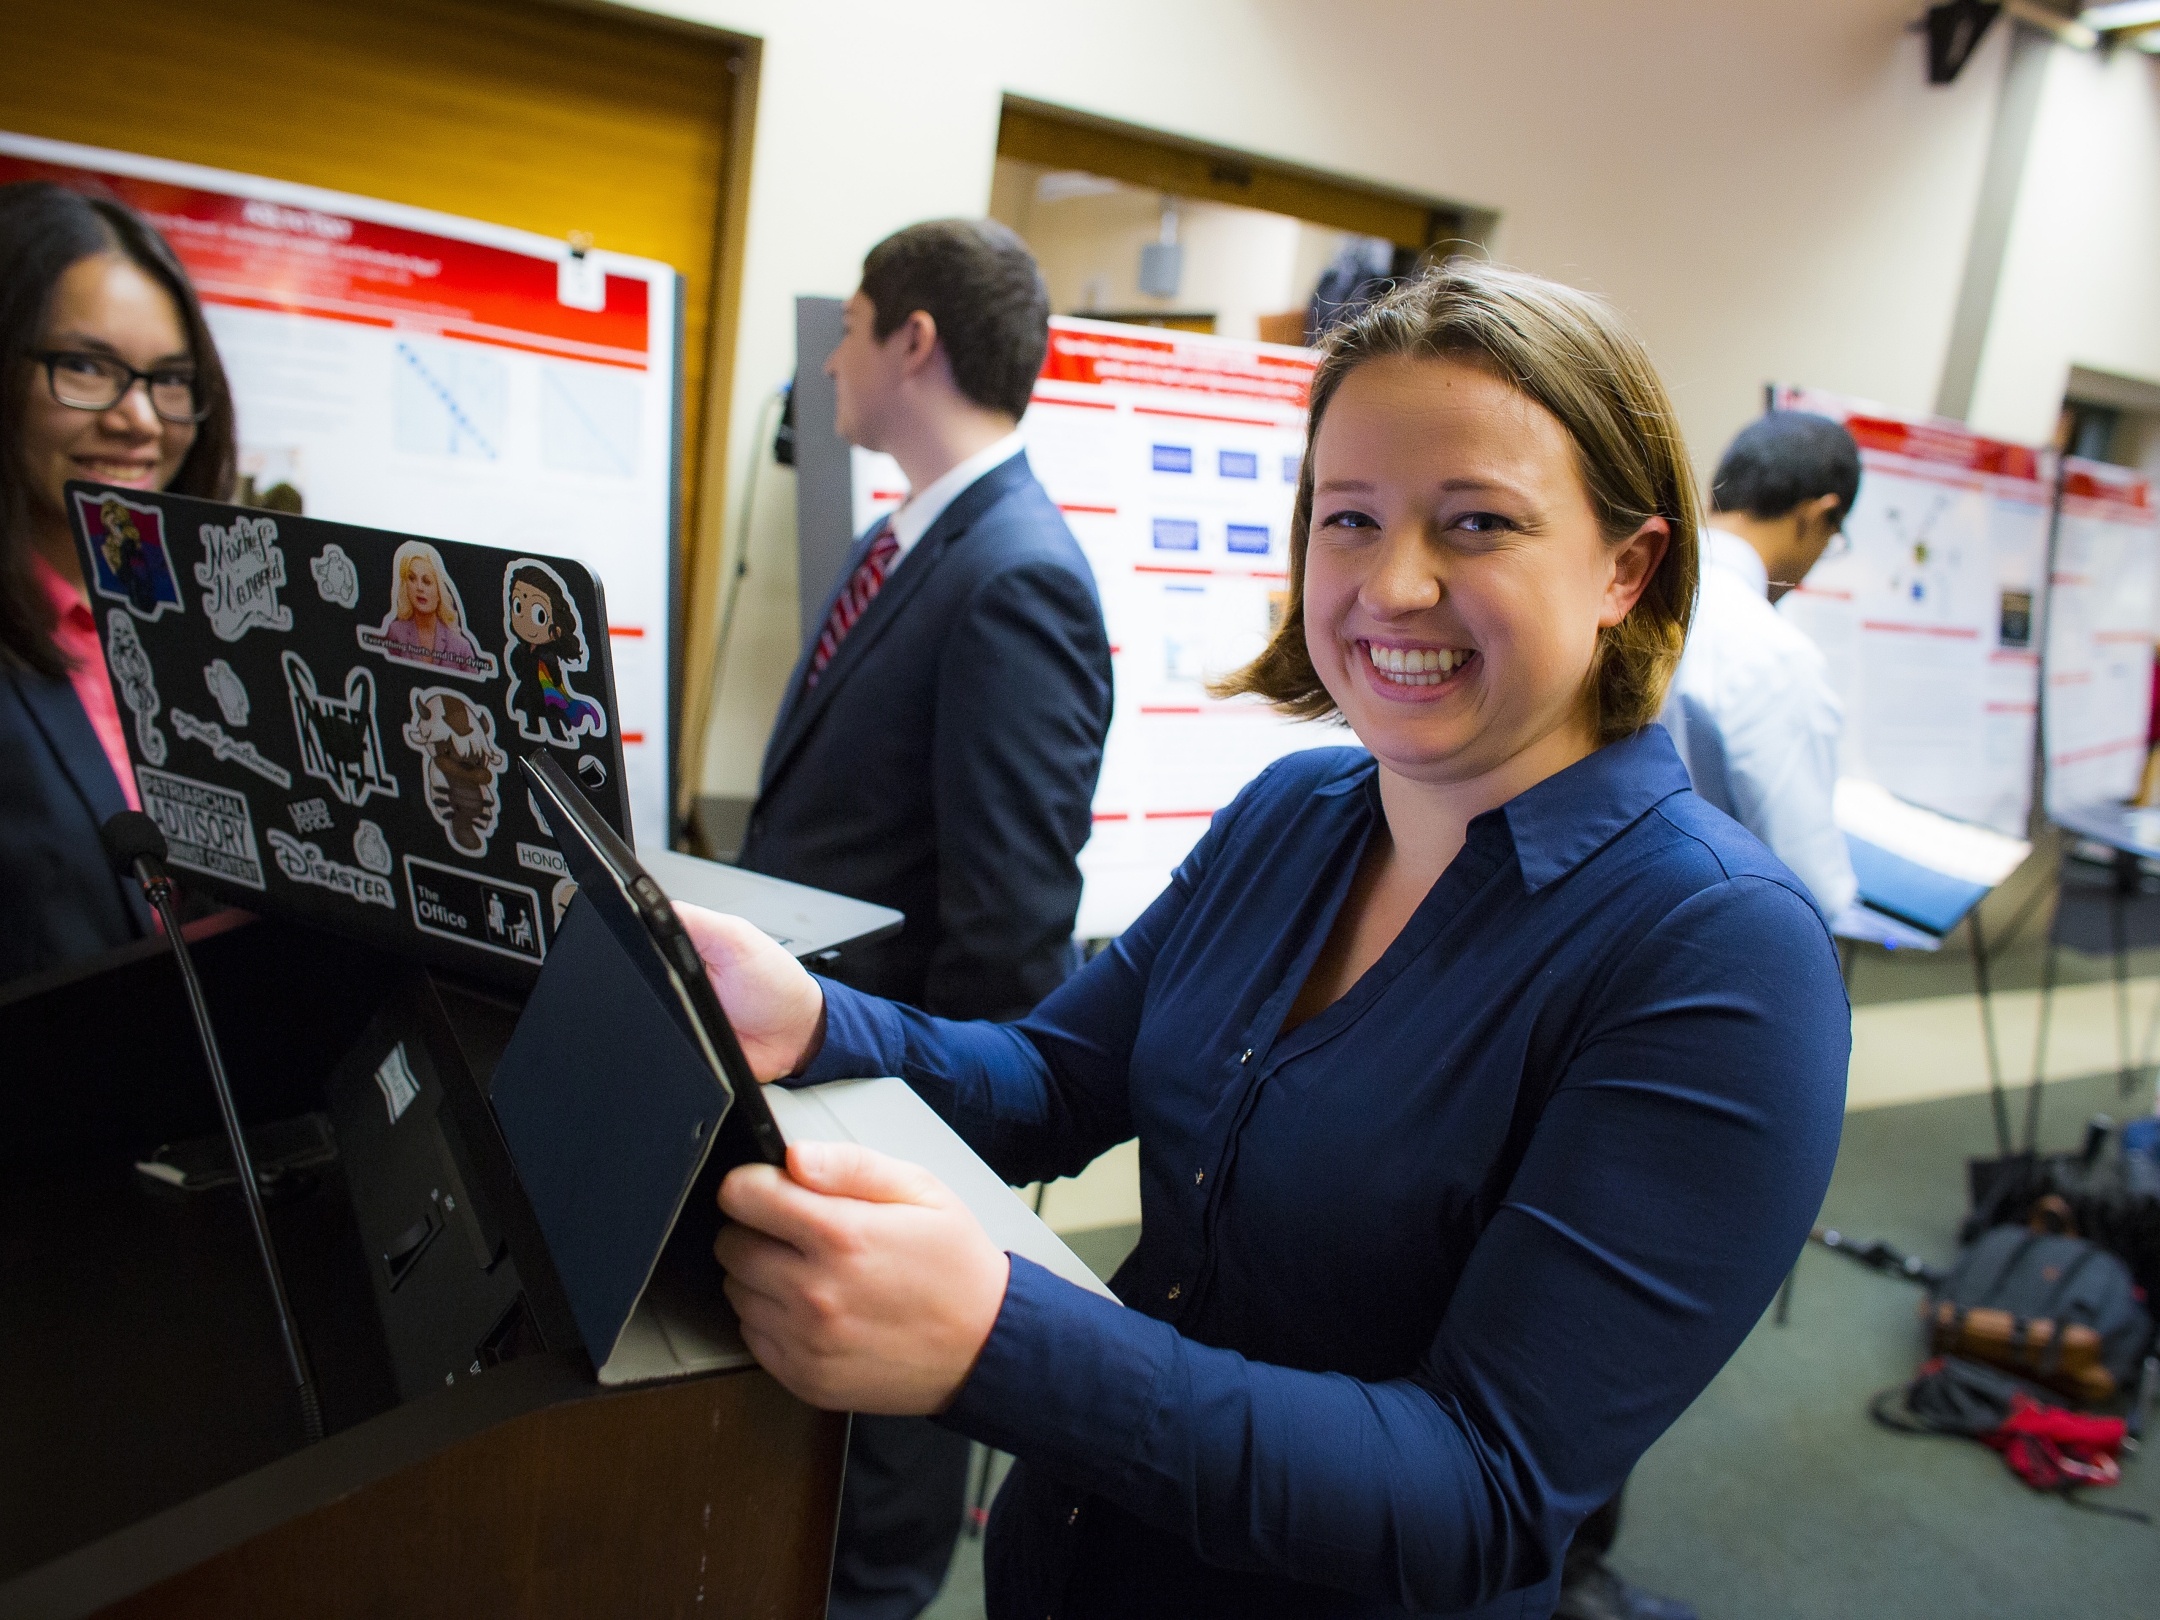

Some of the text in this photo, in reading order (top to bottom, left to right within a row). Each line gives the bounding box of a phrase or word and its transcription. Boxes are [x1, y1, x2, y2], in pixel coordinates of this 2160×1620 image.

[201, 522, 274, 581] Mischief
[205, 553, 283, 617] Managed
[363, 633, 493, 671] Everything hurts and I'm dying.
[142, 772, 243, 817] PATRIARCHAL
[153, 797, 247, 858] ADVISORY
[206, 851, 260, 882] CONTENT
[521, 849, 567, 872] HONO
[416, 884, 440, 902] The
[418, 901, 468, 929] Office
